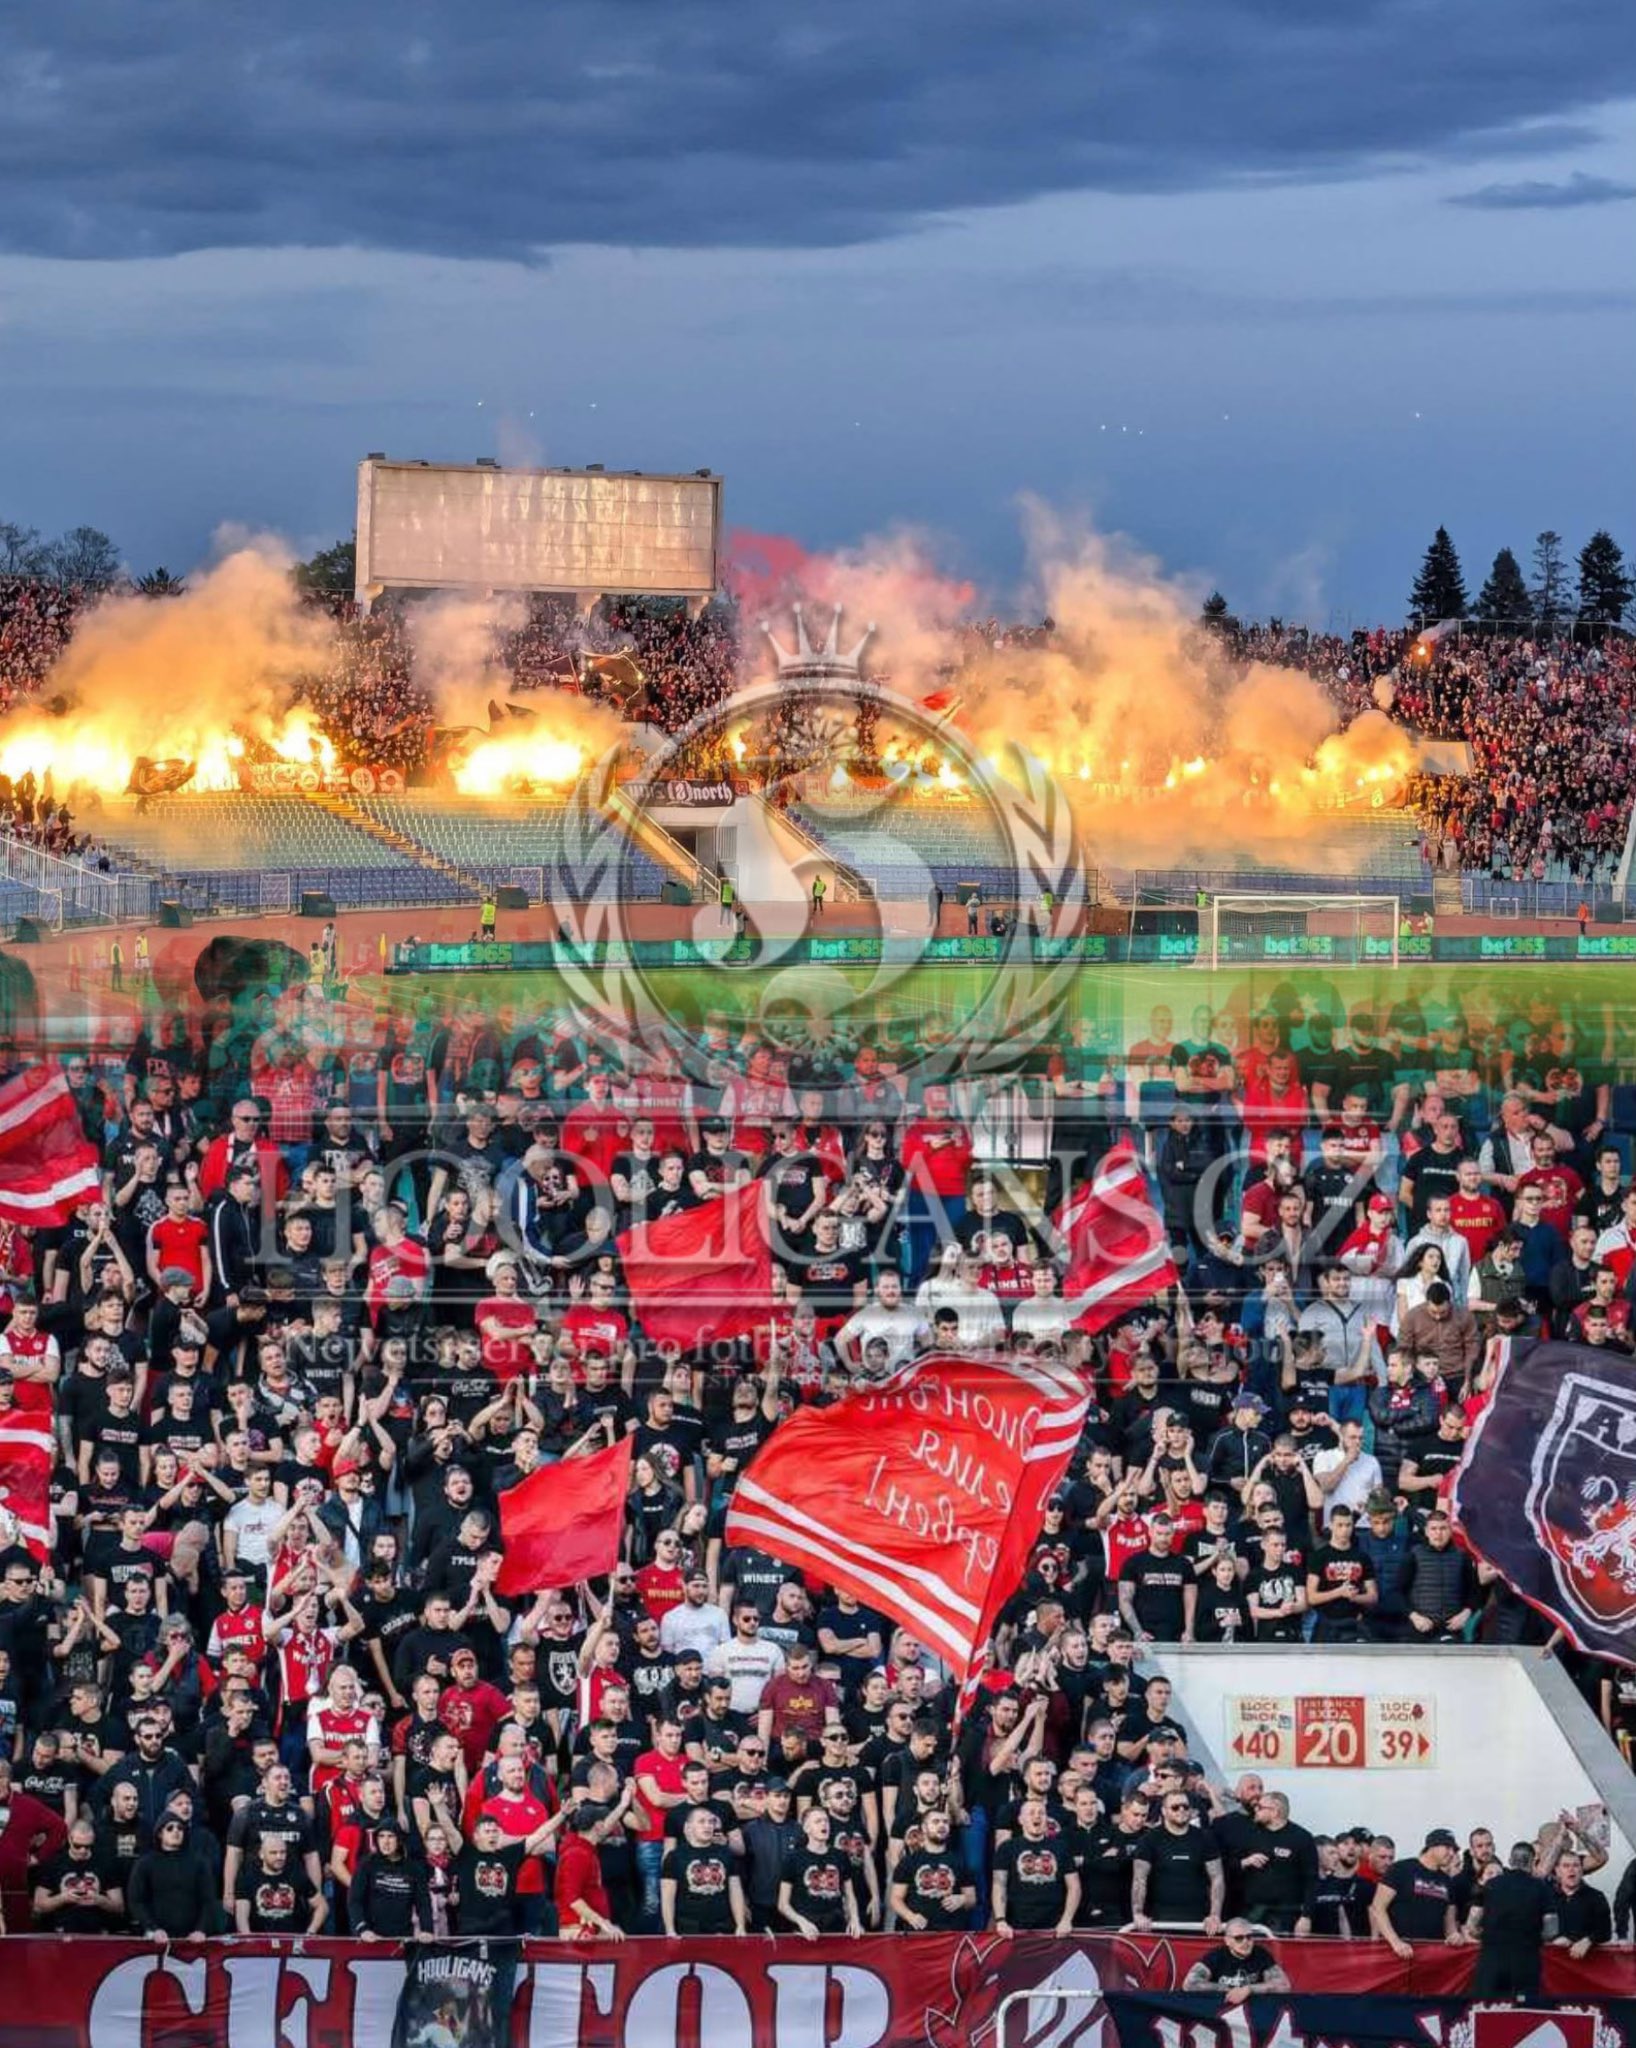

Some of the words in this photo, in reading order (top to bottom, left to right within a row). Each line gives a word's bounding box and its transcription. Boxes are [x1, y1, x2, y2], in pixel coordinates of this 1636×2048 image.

[430, 941, 512, 965] bet365
[810, 938, 882, 959] bet365
[1264, 935, 1332, 955] bet365
[1481, 935, 1545, 954] bet365
[1454, 1217, 1493, 1228] WINBET
[743, 1573, 784, 1584] WINBET
[647, 1588, 684, 1599] WINBE
[1380, 1702, 1412, 1712] BLOC
[1245, 1731, 1280, 1760] 40
[1303, 1721, 1358, 1766] 20
[1380, 1730, 1414, 1761] 39
[416, 1958, 497, 1986] HOOLIGANS
[88, 1956, 891, 2048] СЕТОР
